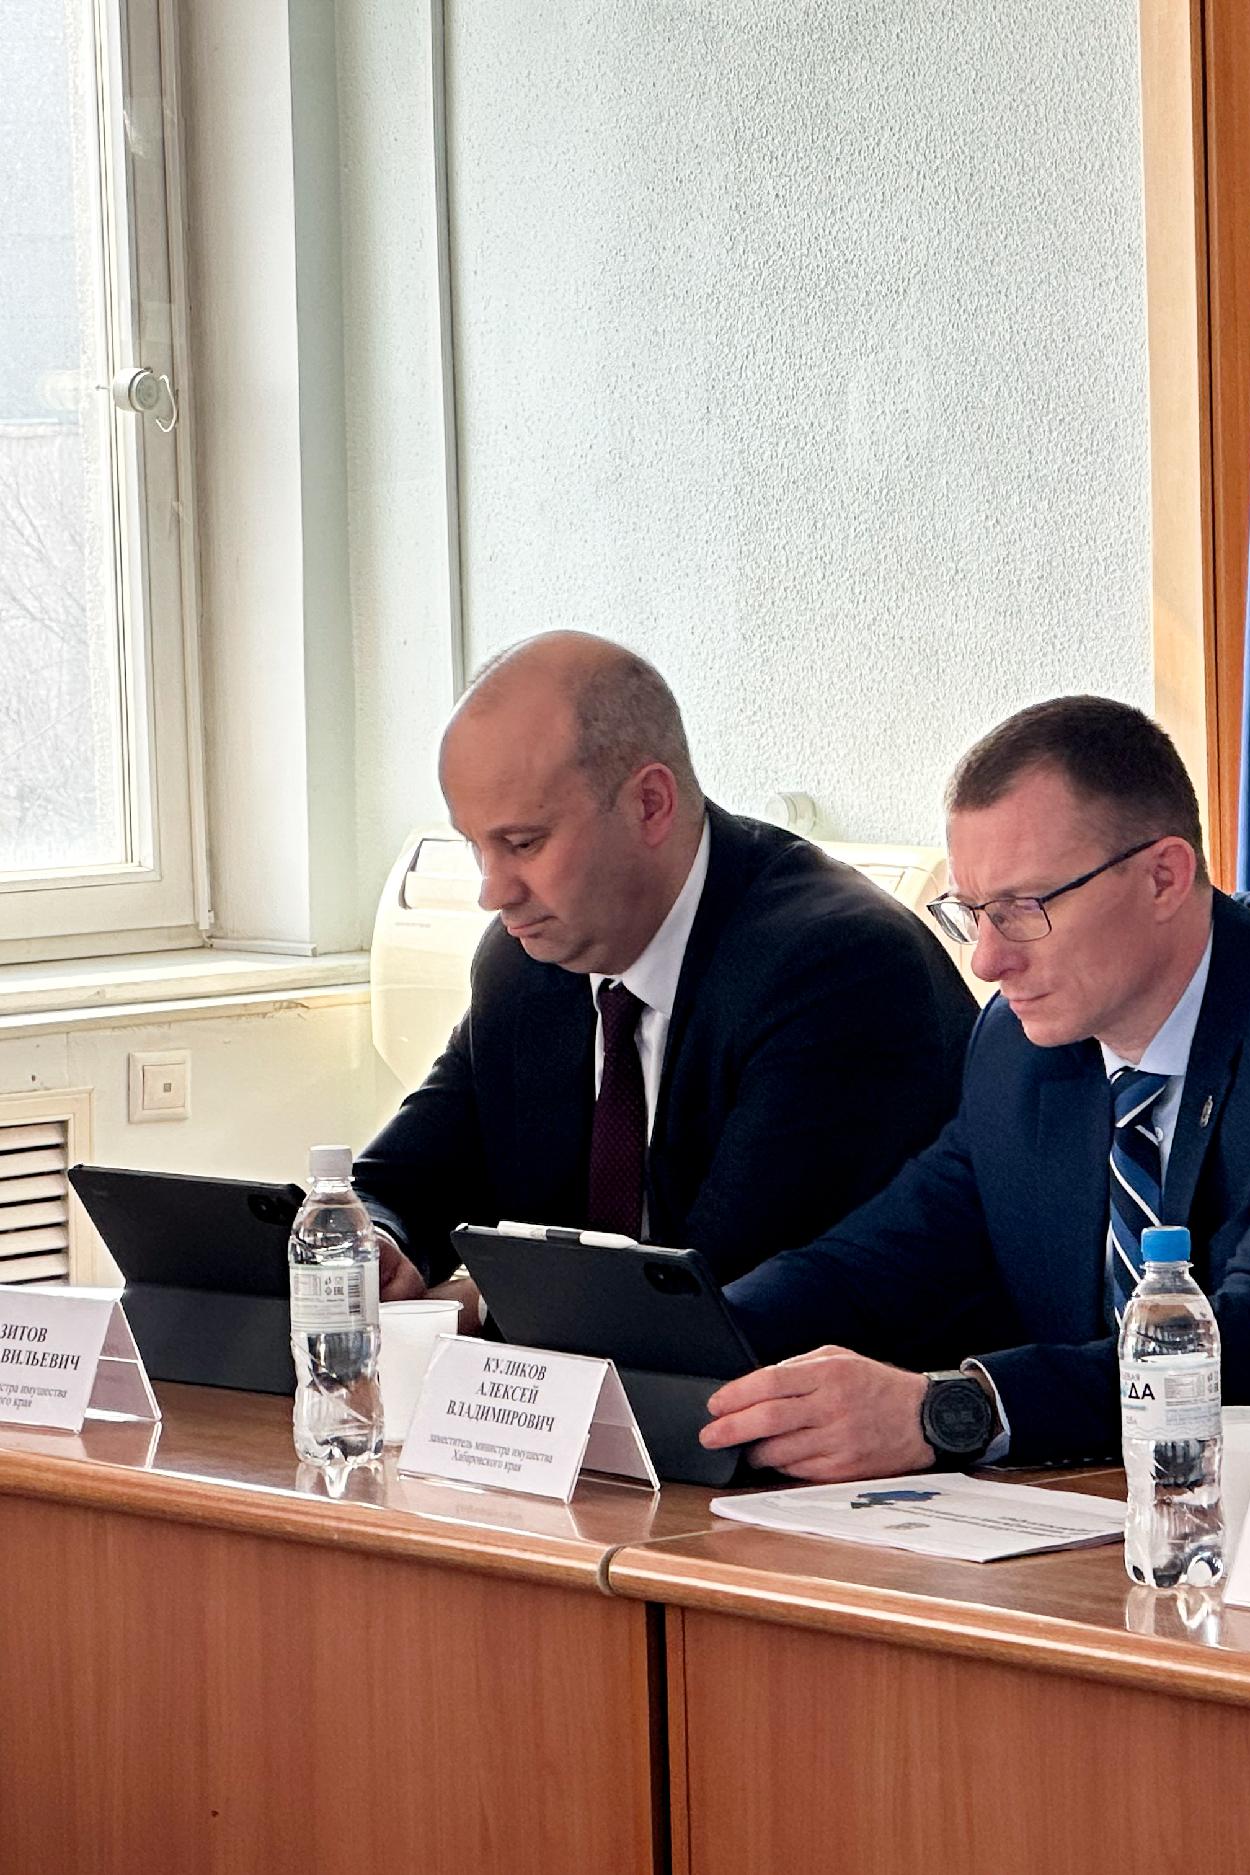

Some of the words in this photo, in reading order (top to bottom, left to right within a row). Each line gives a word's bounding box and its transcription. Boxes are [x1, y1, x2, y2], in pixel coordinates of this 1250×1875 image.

[0, 1323, 48, 1343] ЗИТОВ
[1, 1348, 81, 1371] ВИЛЬЕВИЧ
[483, 1356, 548, 1381] КУЛИКОВ
[476, 1381, 540, 1405] АЛЕКСЕЙ
[446, 1400, 556, 1433] ВЛАДИМИРОВИЧ
